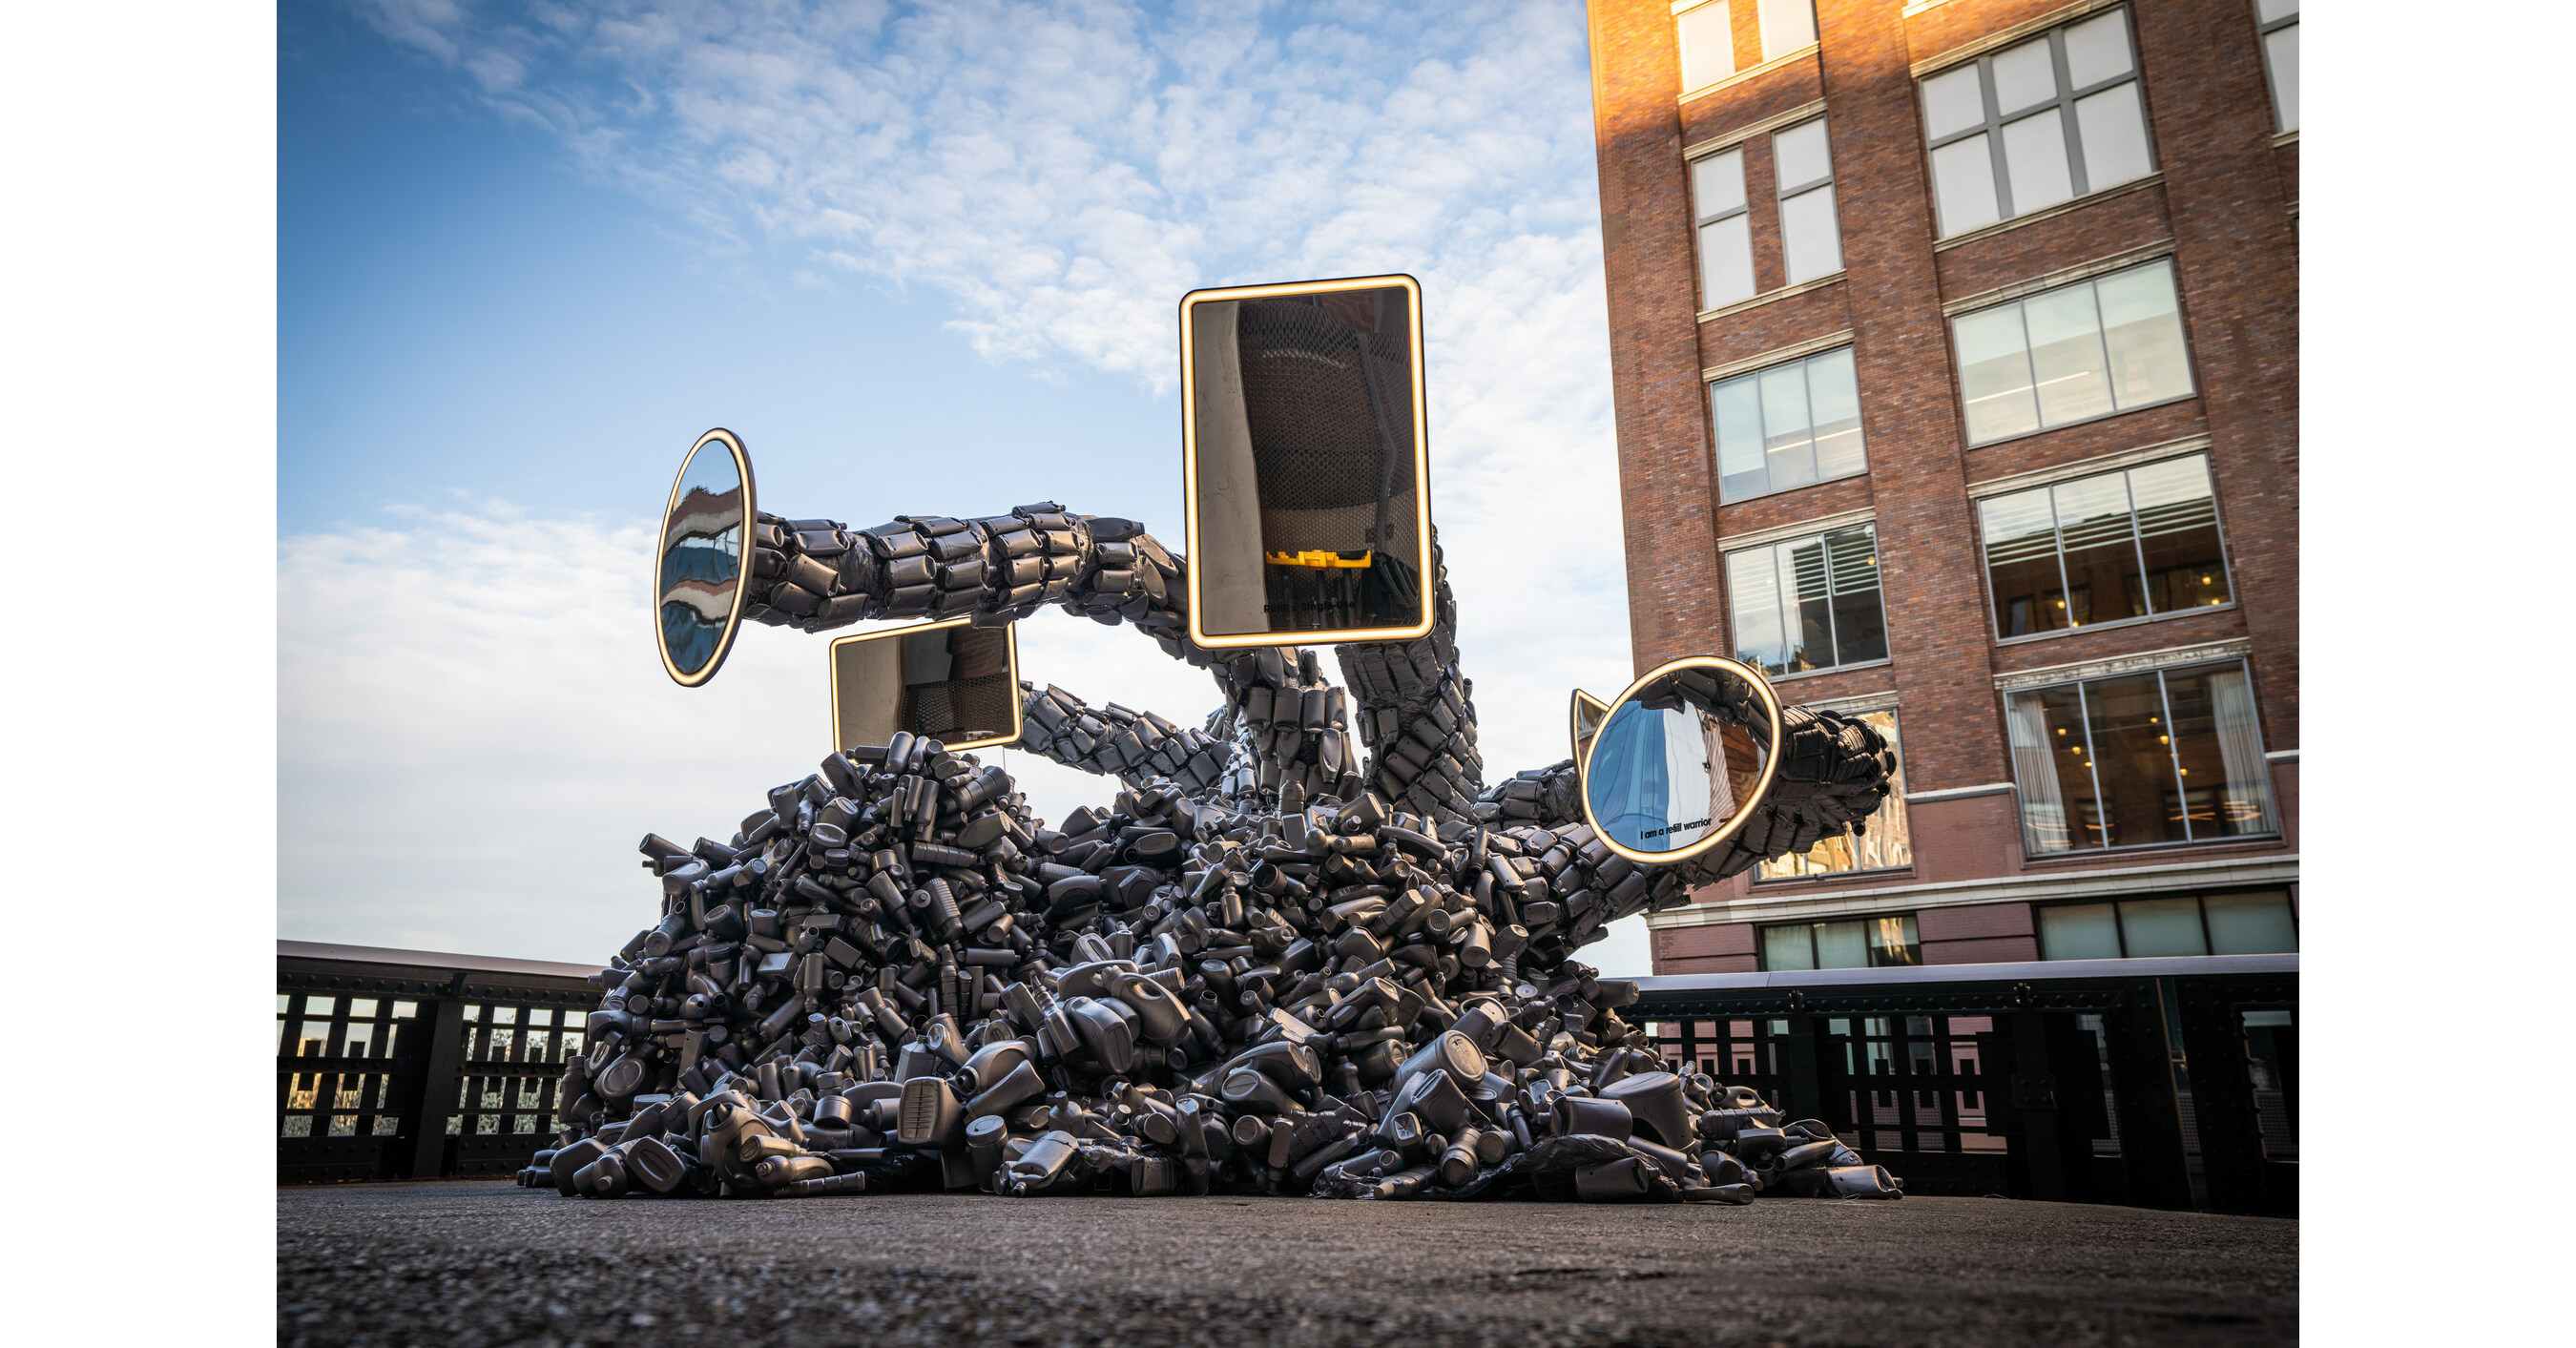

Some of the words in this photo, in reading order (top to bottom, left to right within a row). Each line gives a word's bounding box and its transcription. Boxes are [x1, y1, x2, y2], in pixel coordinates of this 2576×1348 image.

[1640, 831, 1643, 840] I
[1645, 830, 1657, 839] am
[1666, 822, 1682, 834] refill
[1684, 818, 1713, 830] warrior
